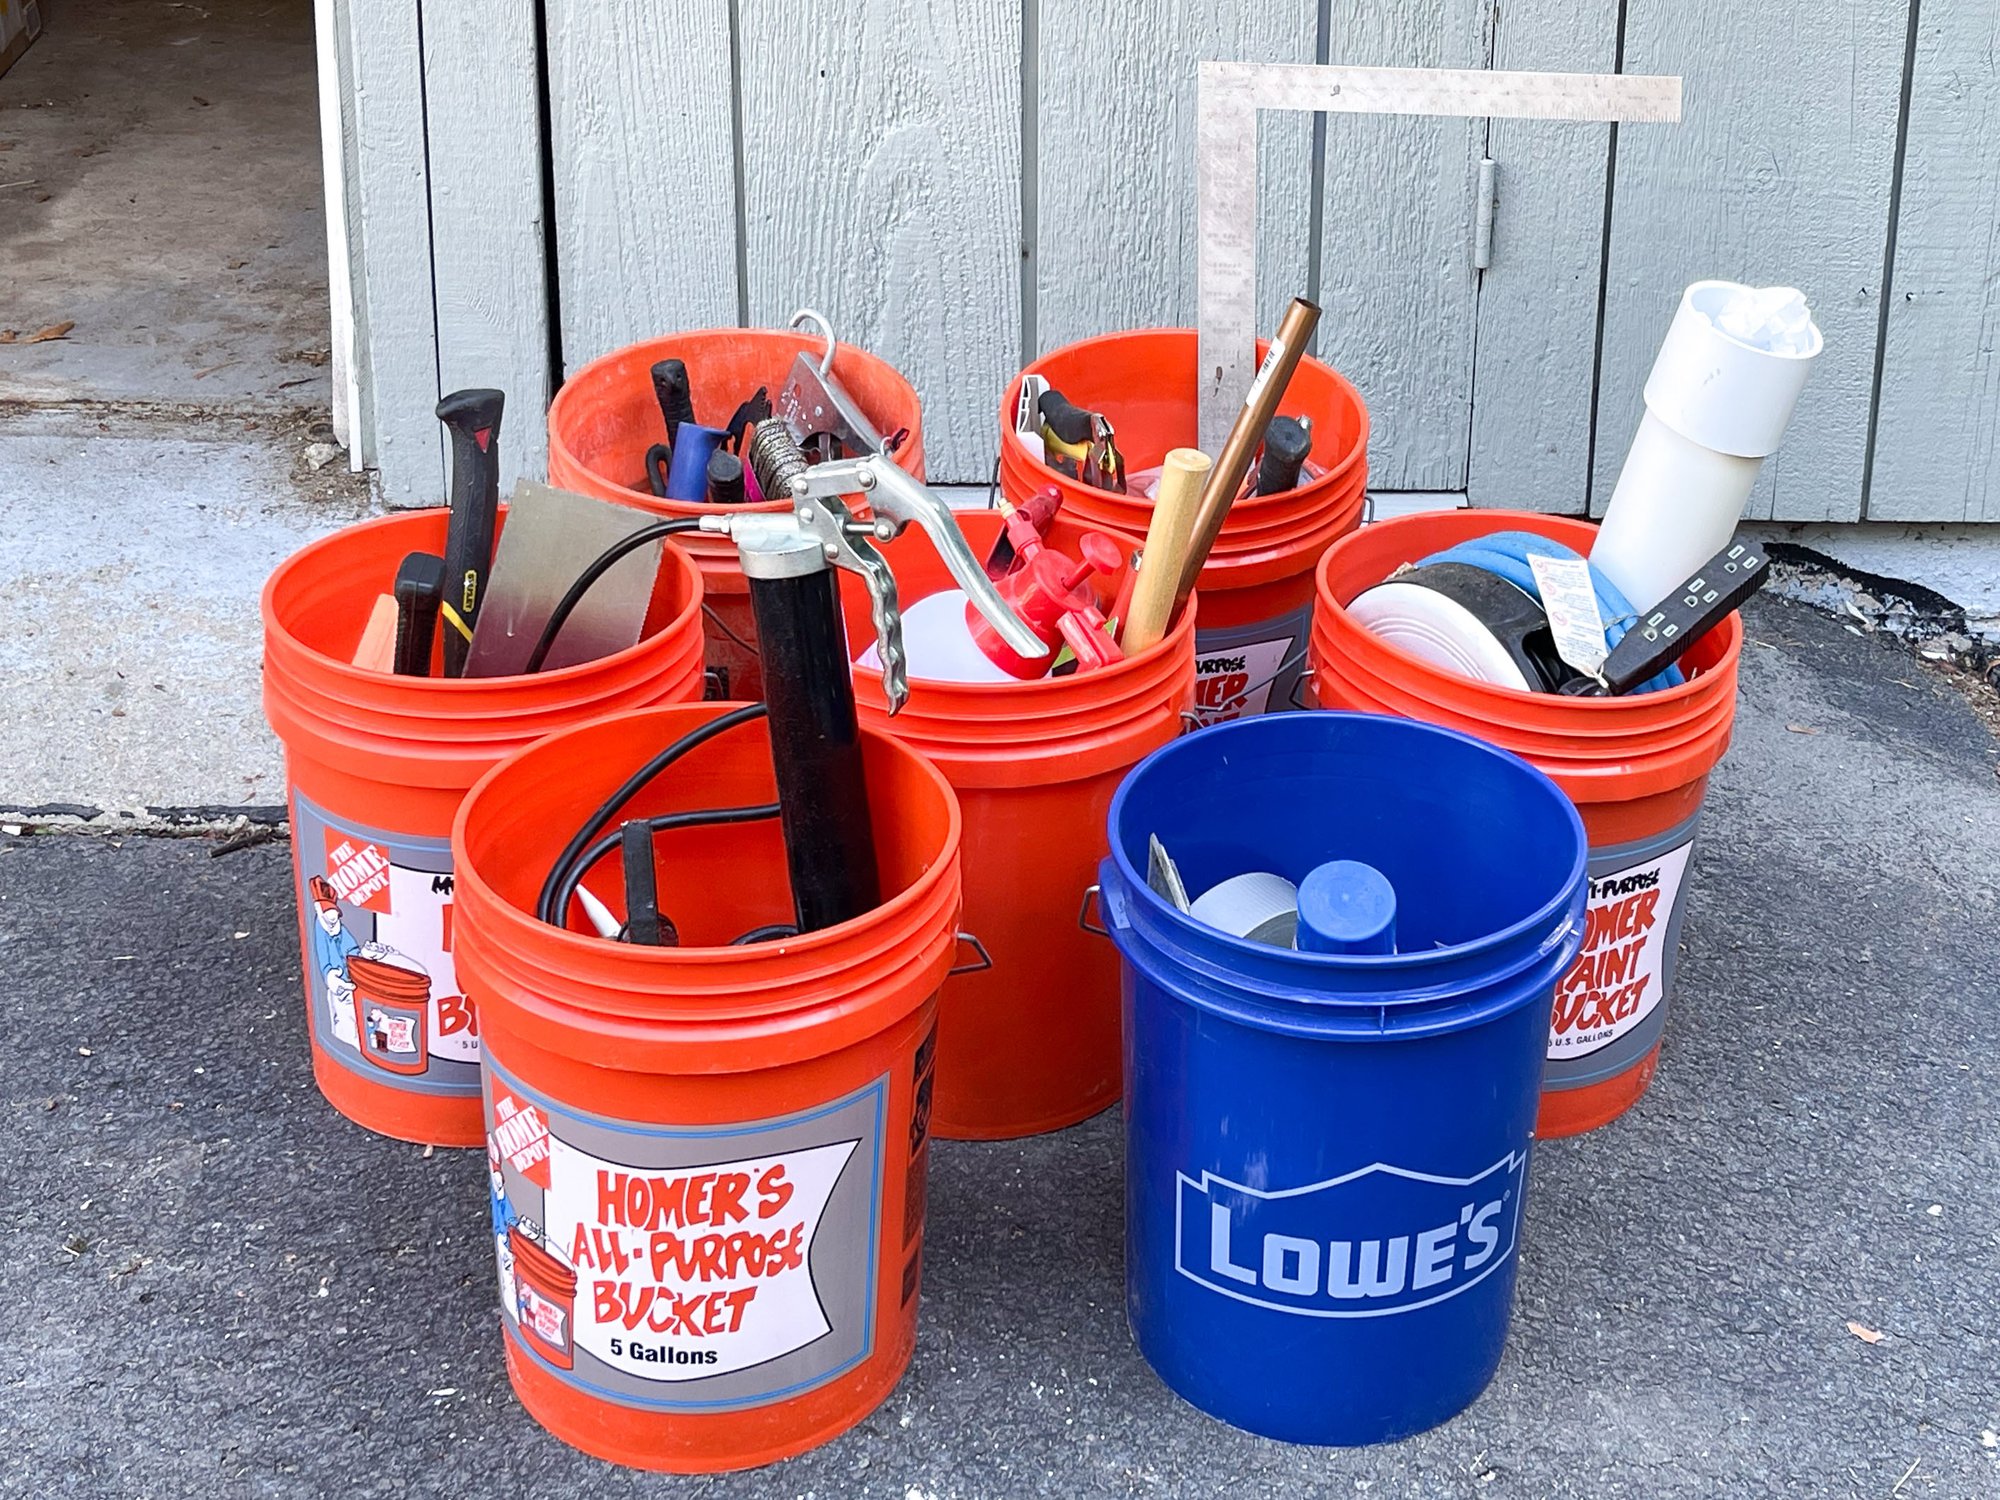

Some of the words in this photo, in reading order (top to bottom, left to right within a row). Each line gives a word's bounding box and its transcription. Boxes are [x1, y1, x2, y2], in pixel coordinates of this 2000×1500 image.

[327, 844, 389, 899] HOME
[329, 841, 356, 866] THE
[348, 871, 389, 906] DEPOT
[1551, 972, 1651, 1035] UCKET
[1577, 1029, 1613, 1044] GALLONS
[495, 1105, 549, 1160] HOME
[511, 1139, 550, 1173] DEPOT
[597, 1164, 794, 1231] HOMER'S
[572, 1221, 804, 1282] ALL-PURPOSE
[1211, 1200, 1503, 1298] LOWE'S
[593, 1280, 758, 1337] BUCKET
[610, 1338, 623, 1355] 5
[629, 1342, 718, 1364] Gallons
